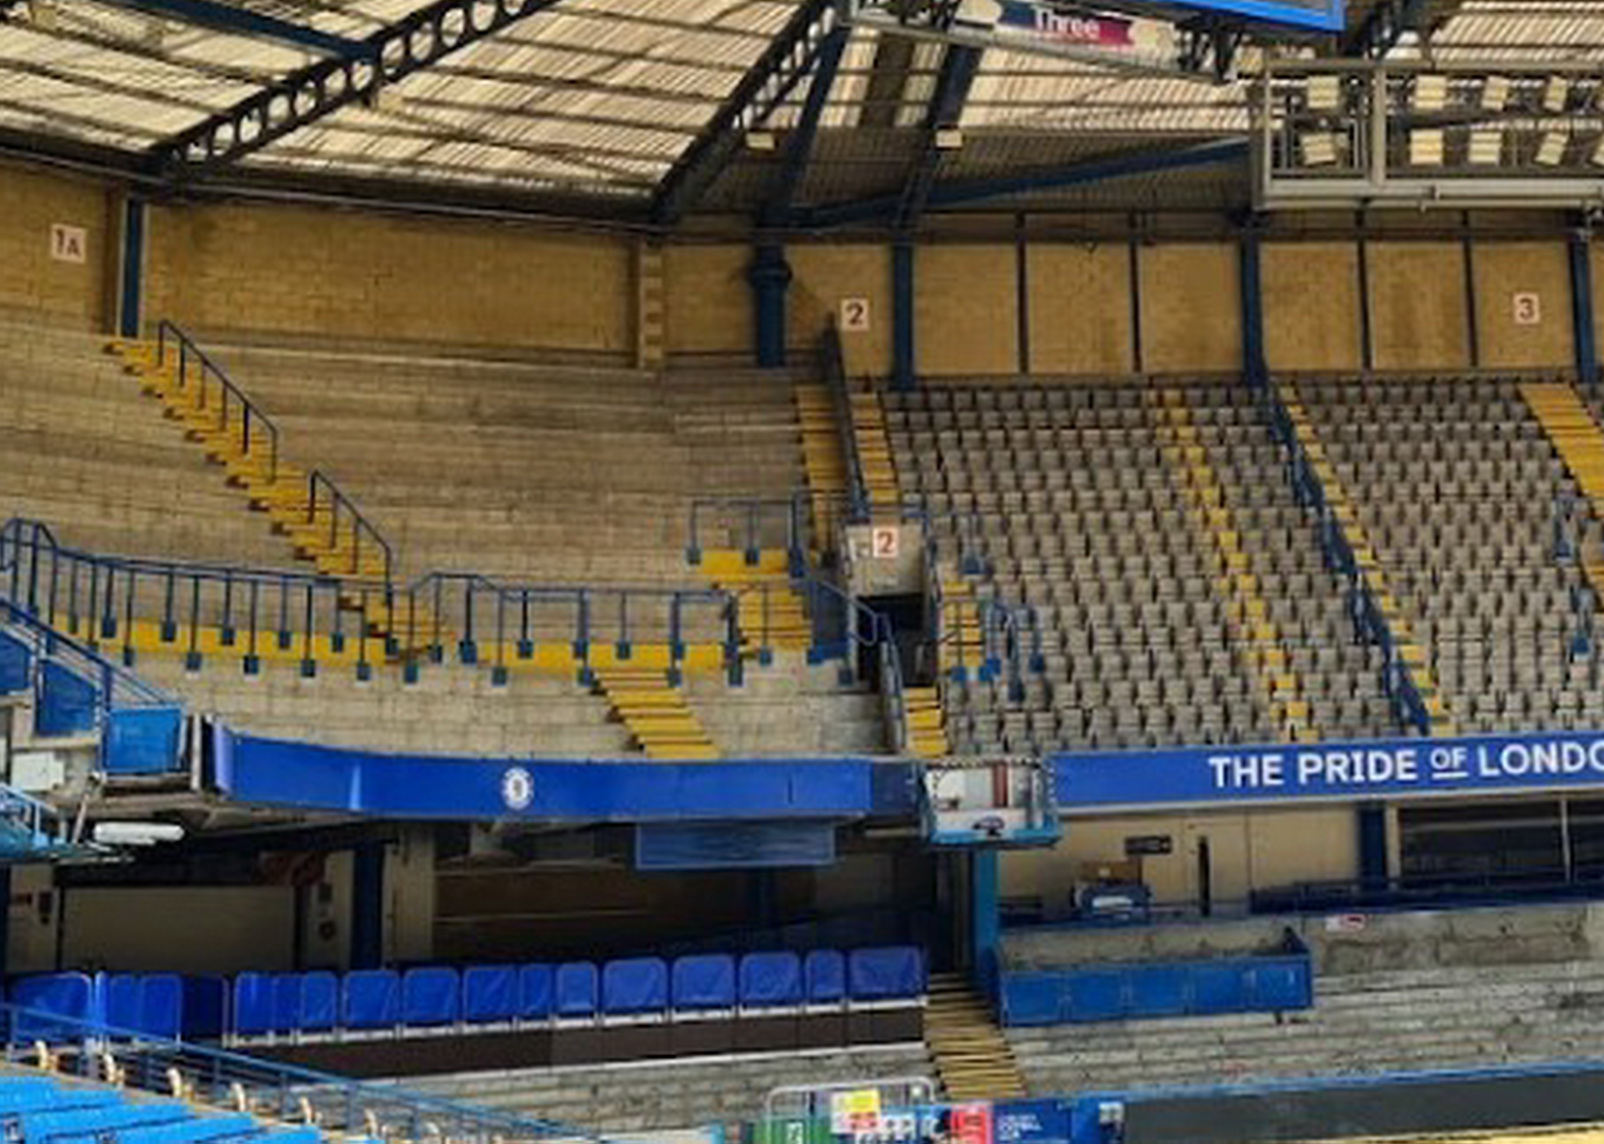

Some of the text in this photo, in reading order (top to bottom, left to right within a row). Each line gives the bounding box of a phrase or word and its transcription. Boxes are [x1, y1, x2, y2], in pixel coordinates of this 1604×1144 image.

[1032, 4, 1100, 39] Three
[56, 229, 81, 257] 1A
[845, 302, 863, 326] 2
[1519, 297, 1535, 320] 3
[878, 531, 894, 554] 2
[1209, 756, 1284, 788] THE
[1298, 750, 1418, 784] PRIDE
[1430, 747, 1469, 778] OF
